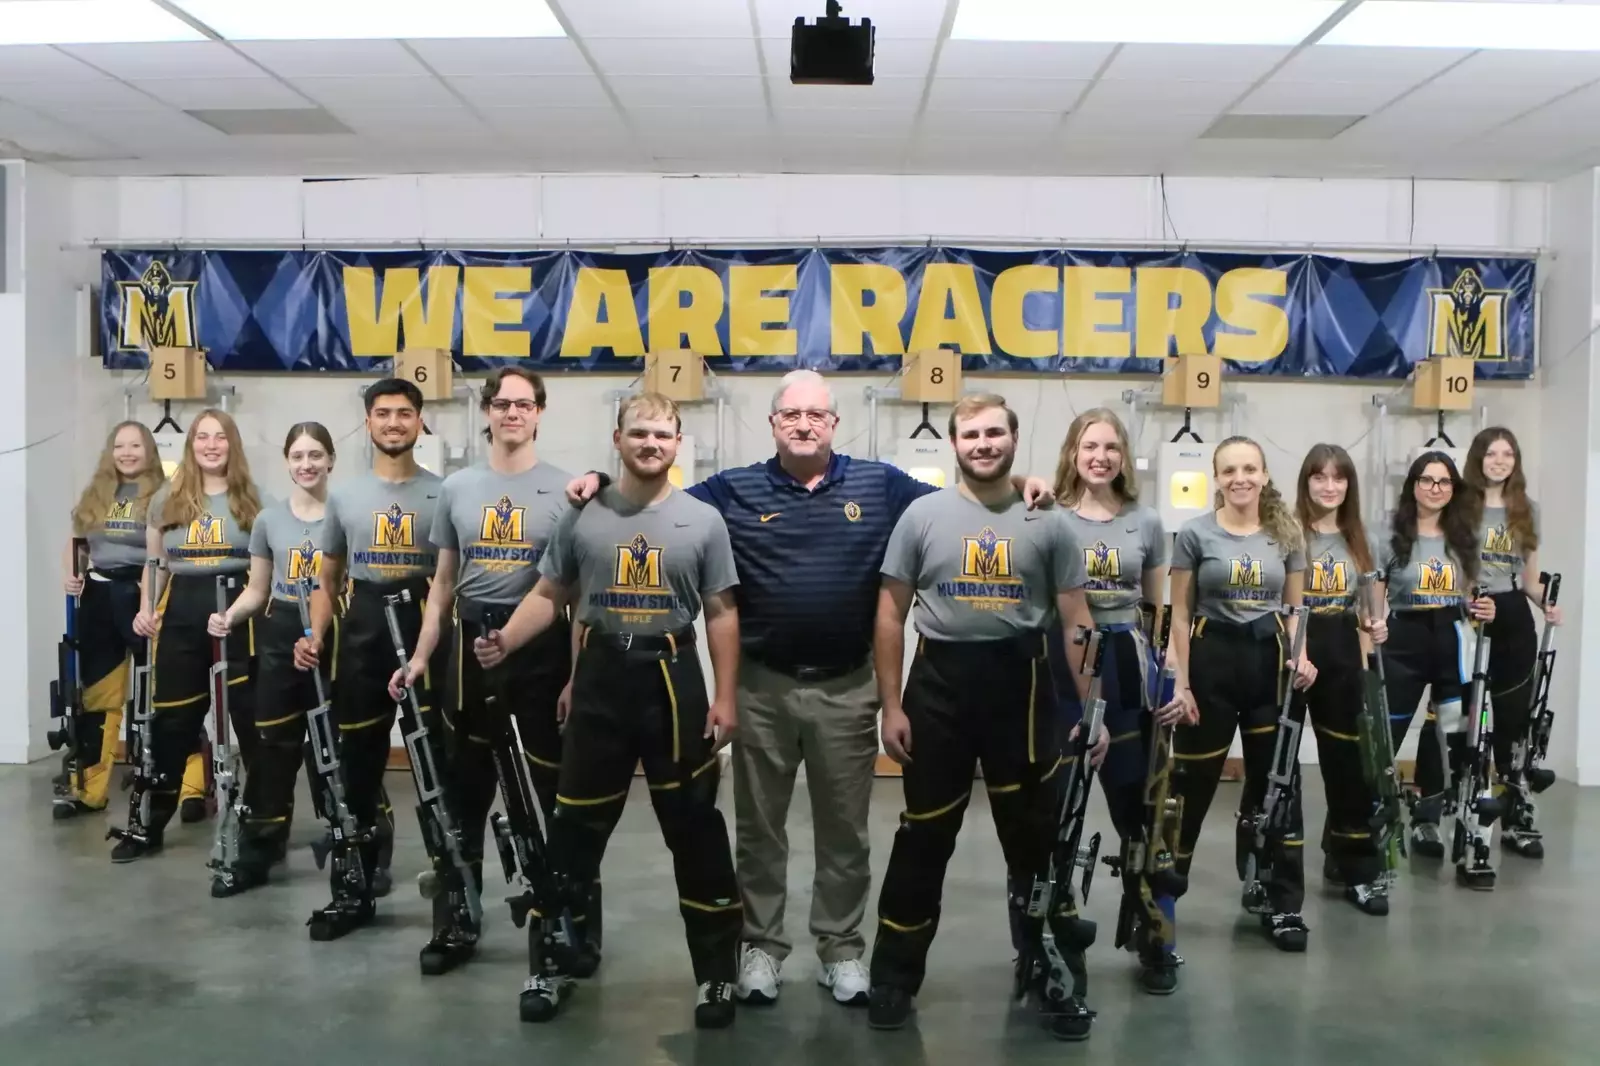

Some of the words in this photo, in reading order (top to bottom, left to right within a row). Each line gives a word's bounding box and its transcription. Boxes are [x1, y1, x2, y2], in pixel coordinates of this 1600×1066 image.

[343, 266, 532, 357] WE
[559, 264, 798, 357] ARE
[831, 263, 1289, 362] RACERS
[163, 362, 176, 380] 5
[414, 366, 428, 383] 6
[669, 366, 682, 383] 7
[930, 366, 944, 384] 8
[1196, 372, 1210, 389] 9
[1445, 376, 1468, 393] 10
[353, 552, 400, 564] MURRAY
[511, 548, 541, 561] STAT
[937, 582, 996, 597] MURRAY
[999, 584, 1032, 600] STAT
[588, 593, 647, 609] MURRAY
[972, 601, 1004, 611] RIFLE
